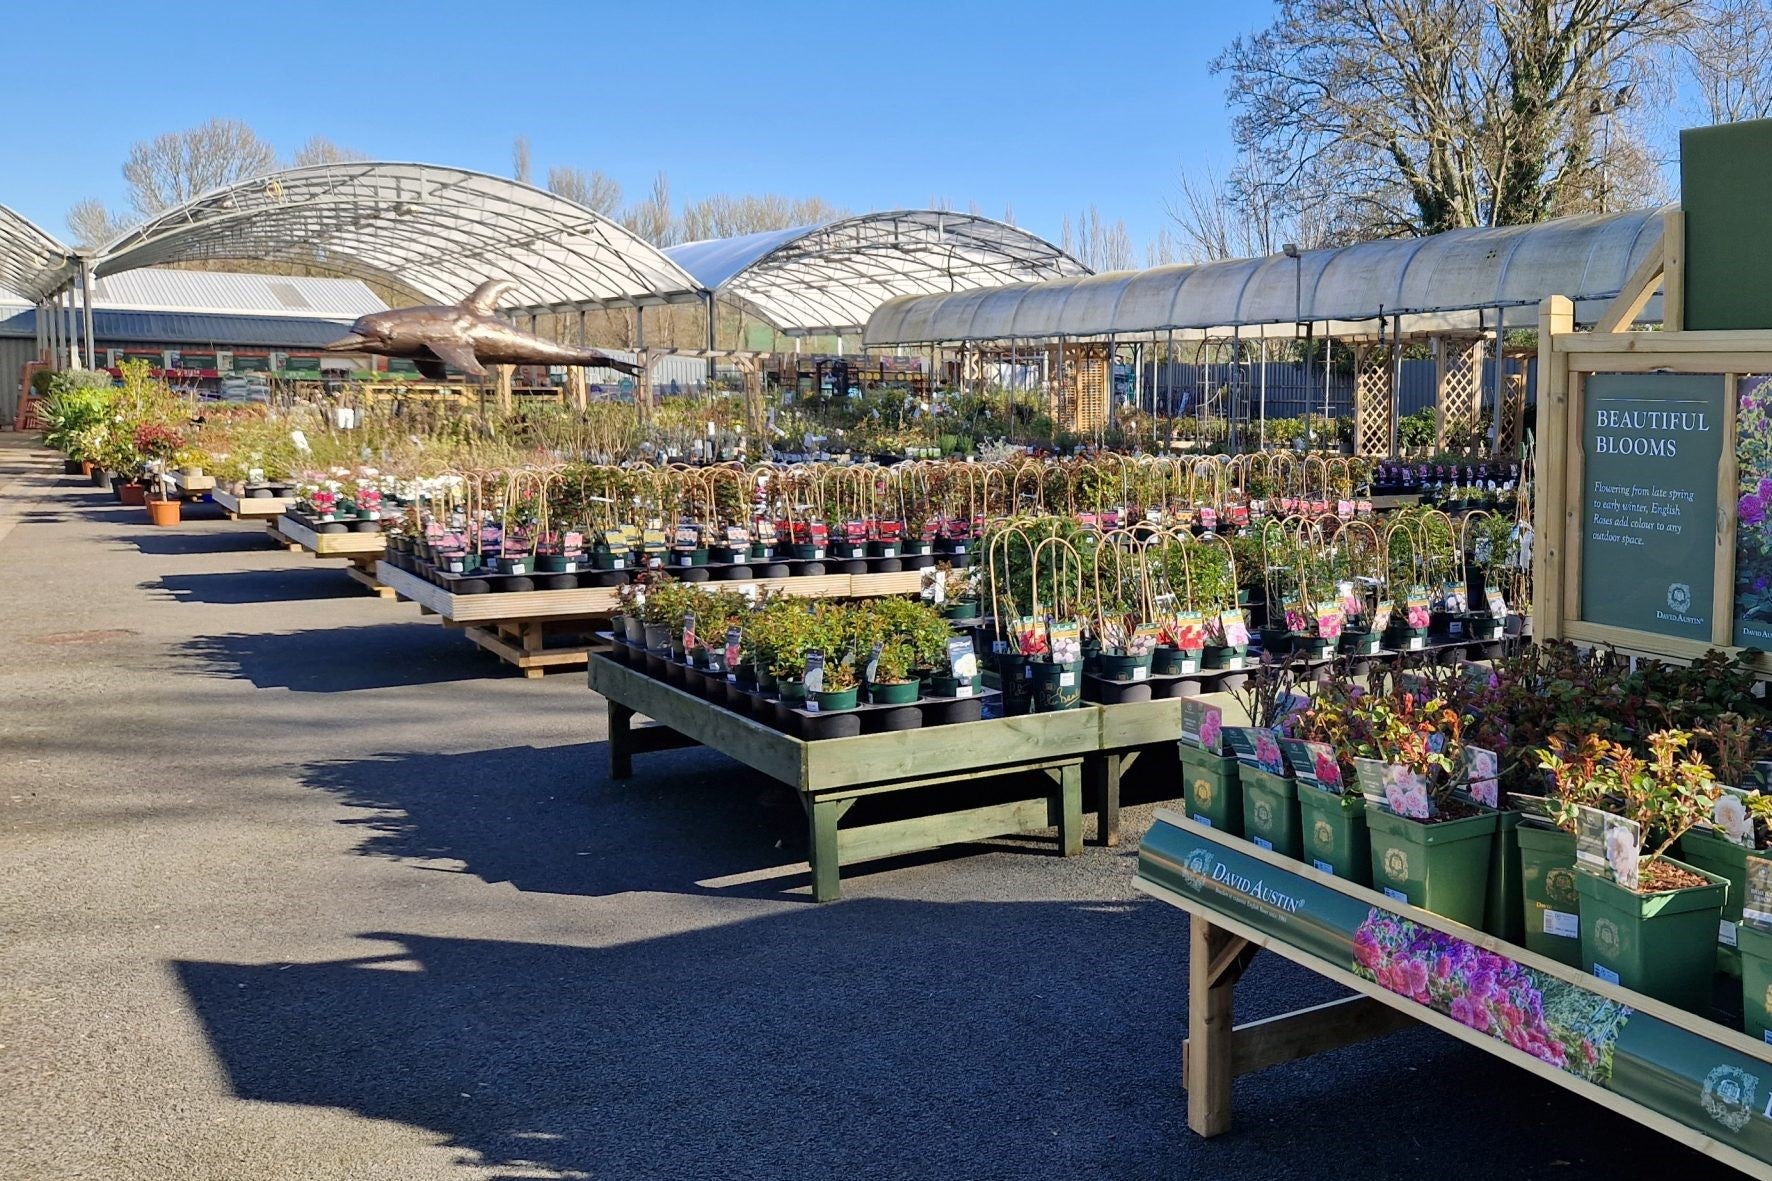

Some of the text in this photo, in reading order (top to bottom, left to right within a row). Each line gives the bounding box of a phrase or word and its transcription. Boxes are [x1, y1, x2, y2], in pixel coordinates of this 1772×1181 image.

[1597, 410, 1710, 431] BEAUTIFUL
[1596, 436, 1676, 457] BLOOMS
[1594, 481, 1694, 502] Flowering from late spring
[1593, 499, 1681, 517] to early winter, English
[1593, 513, 1682, 535] Roses add colour to any
[1592, 530, 1645, 546] outdoor space.
[1656, 610, 1677, 621] DAVID
[1212, 863, 1250, 893] DAVID
